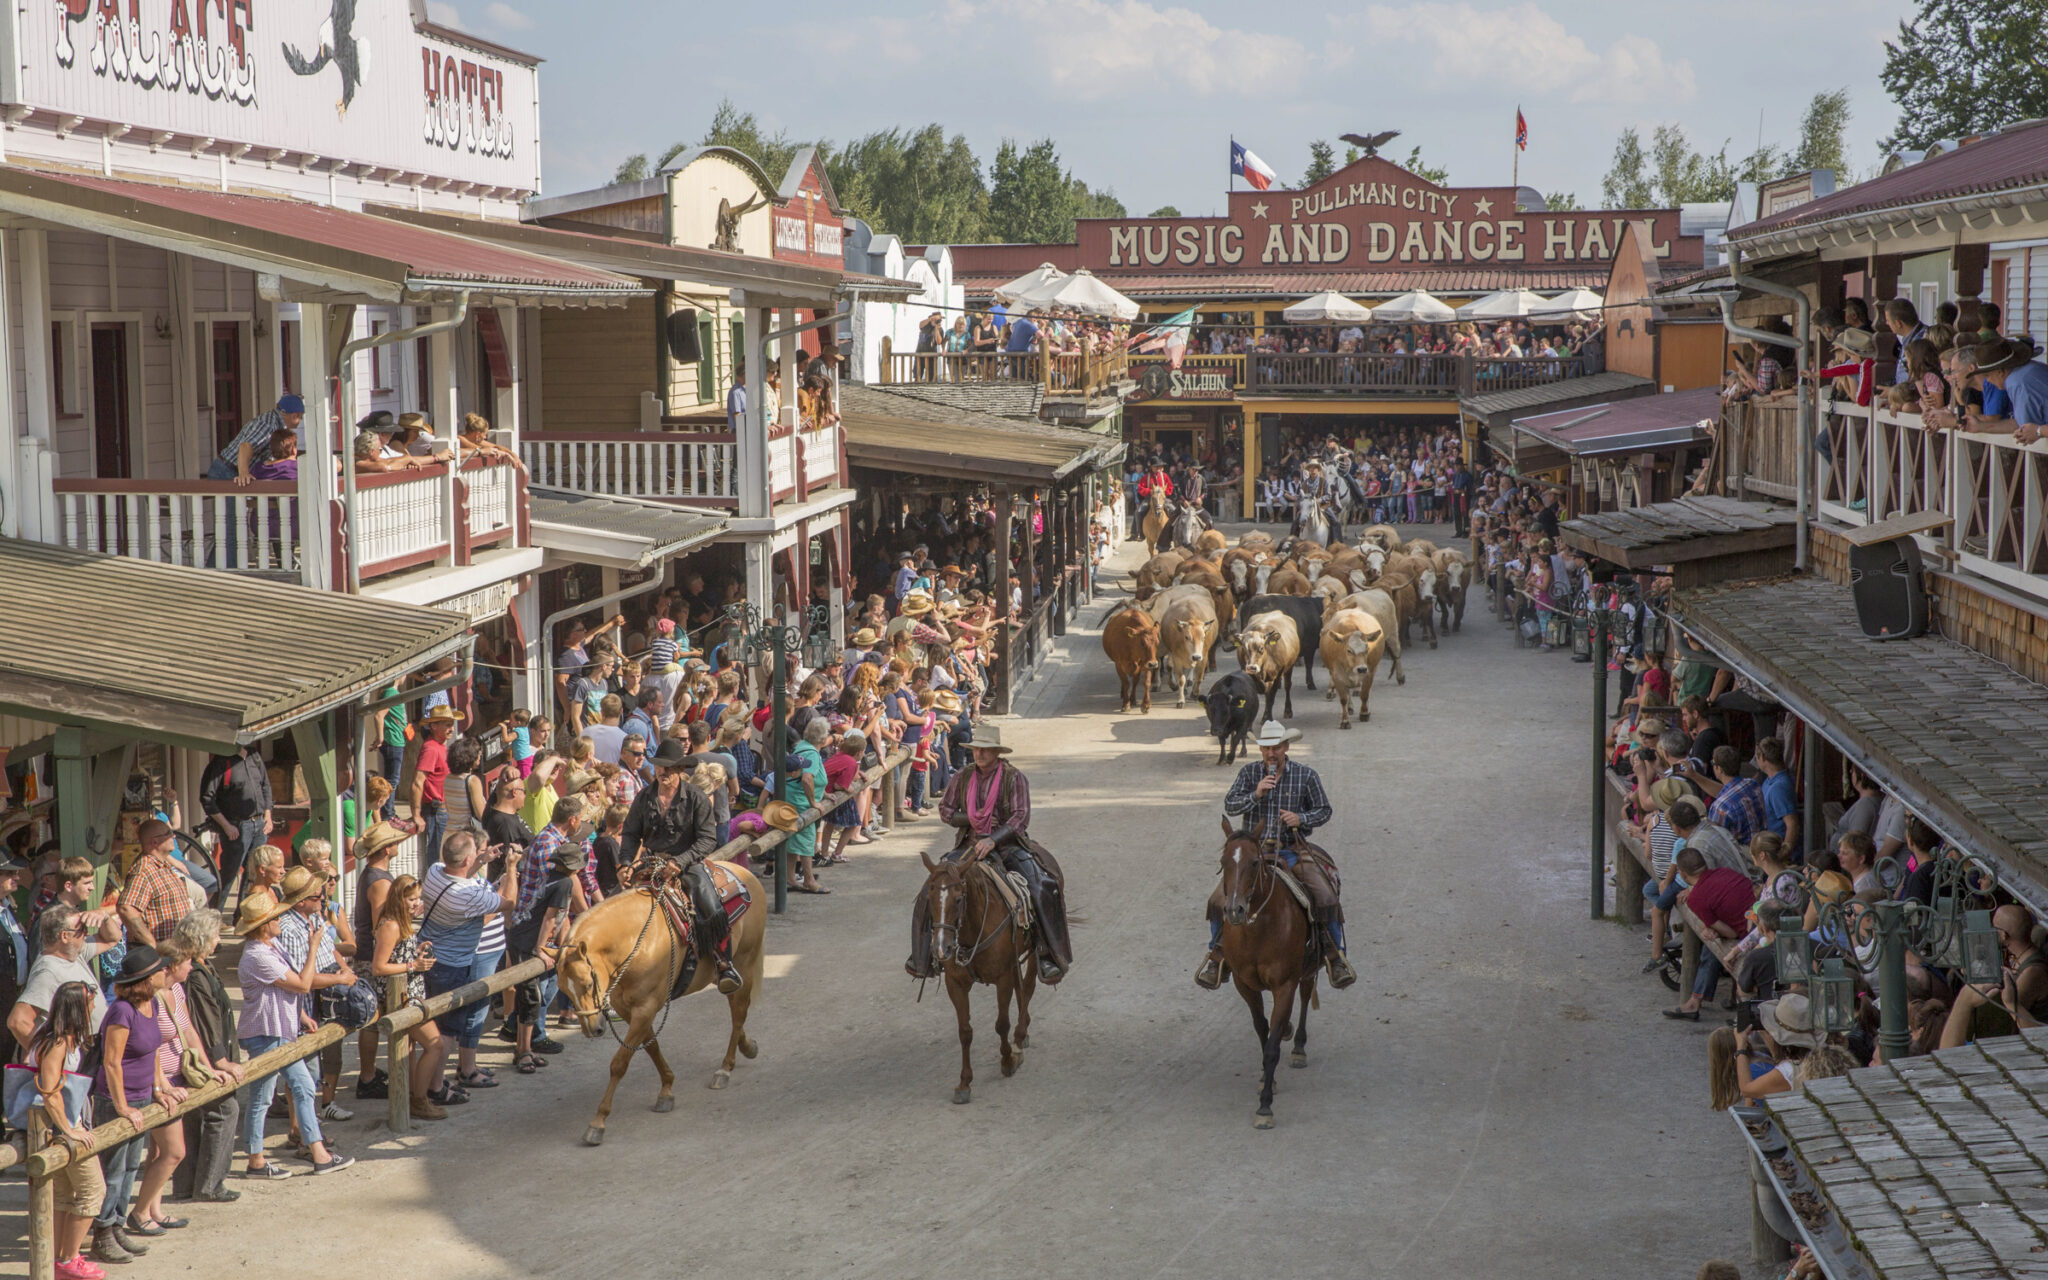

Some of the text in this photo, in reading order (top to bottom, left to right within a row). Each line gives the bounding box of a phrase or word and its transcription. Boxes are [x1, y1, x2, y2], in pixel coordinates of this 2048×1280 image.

[55, 0, 514, 160] PALACE HOTEL
[1291, 183, 1459, 219] PULLMAN CITY
[1109, 225, 1243, 266] MUSIC
[1262, 223, 1349, 264] AND
[1368, 220, 1525, 263] DANCE
[1169, 369, 1232, 397] SALOON
[1182, 390, 1229, 399] WELCOME
